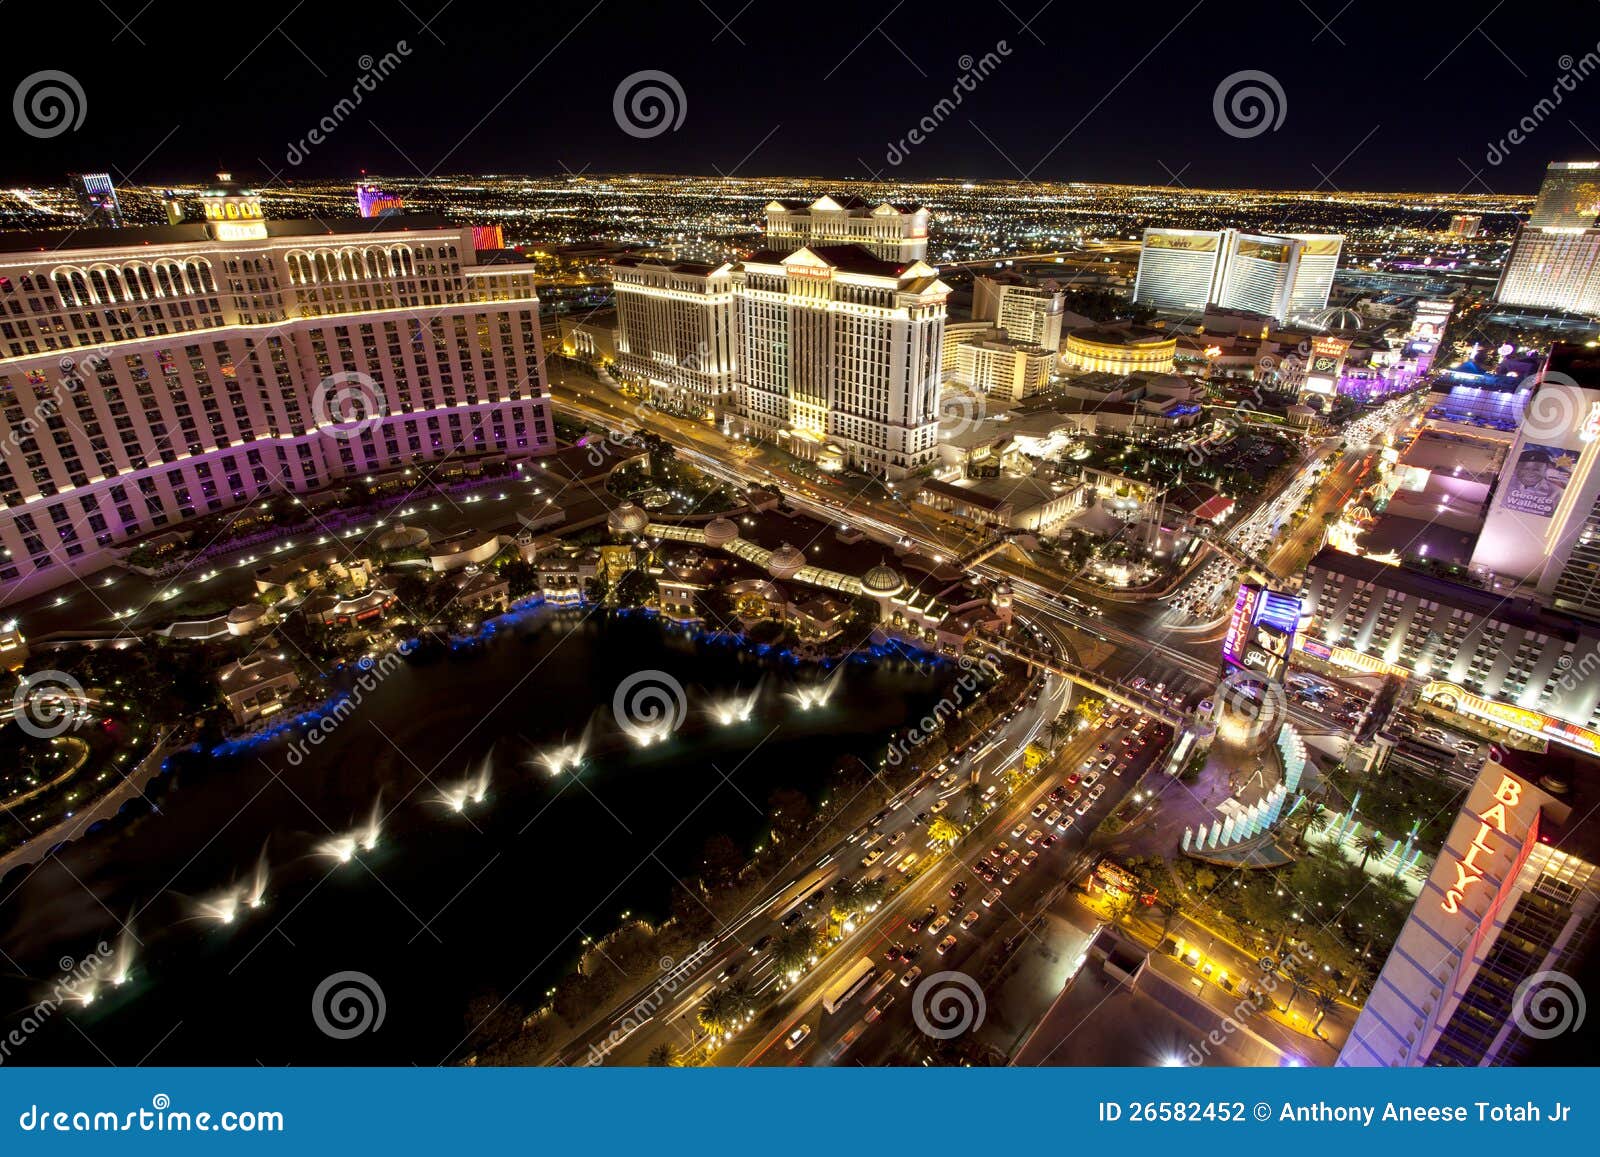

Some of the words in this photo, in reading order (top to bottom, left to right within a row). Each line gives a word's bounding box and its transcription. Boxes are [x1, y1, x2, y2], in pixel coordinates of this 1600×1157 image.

[1506, 495, 1553, 512] Wallace
[1510, 488, 1554, 505] George
[1232, 591, 1255, 652] BALLYS
[1440, 773, 1523, 915] BALLYS
